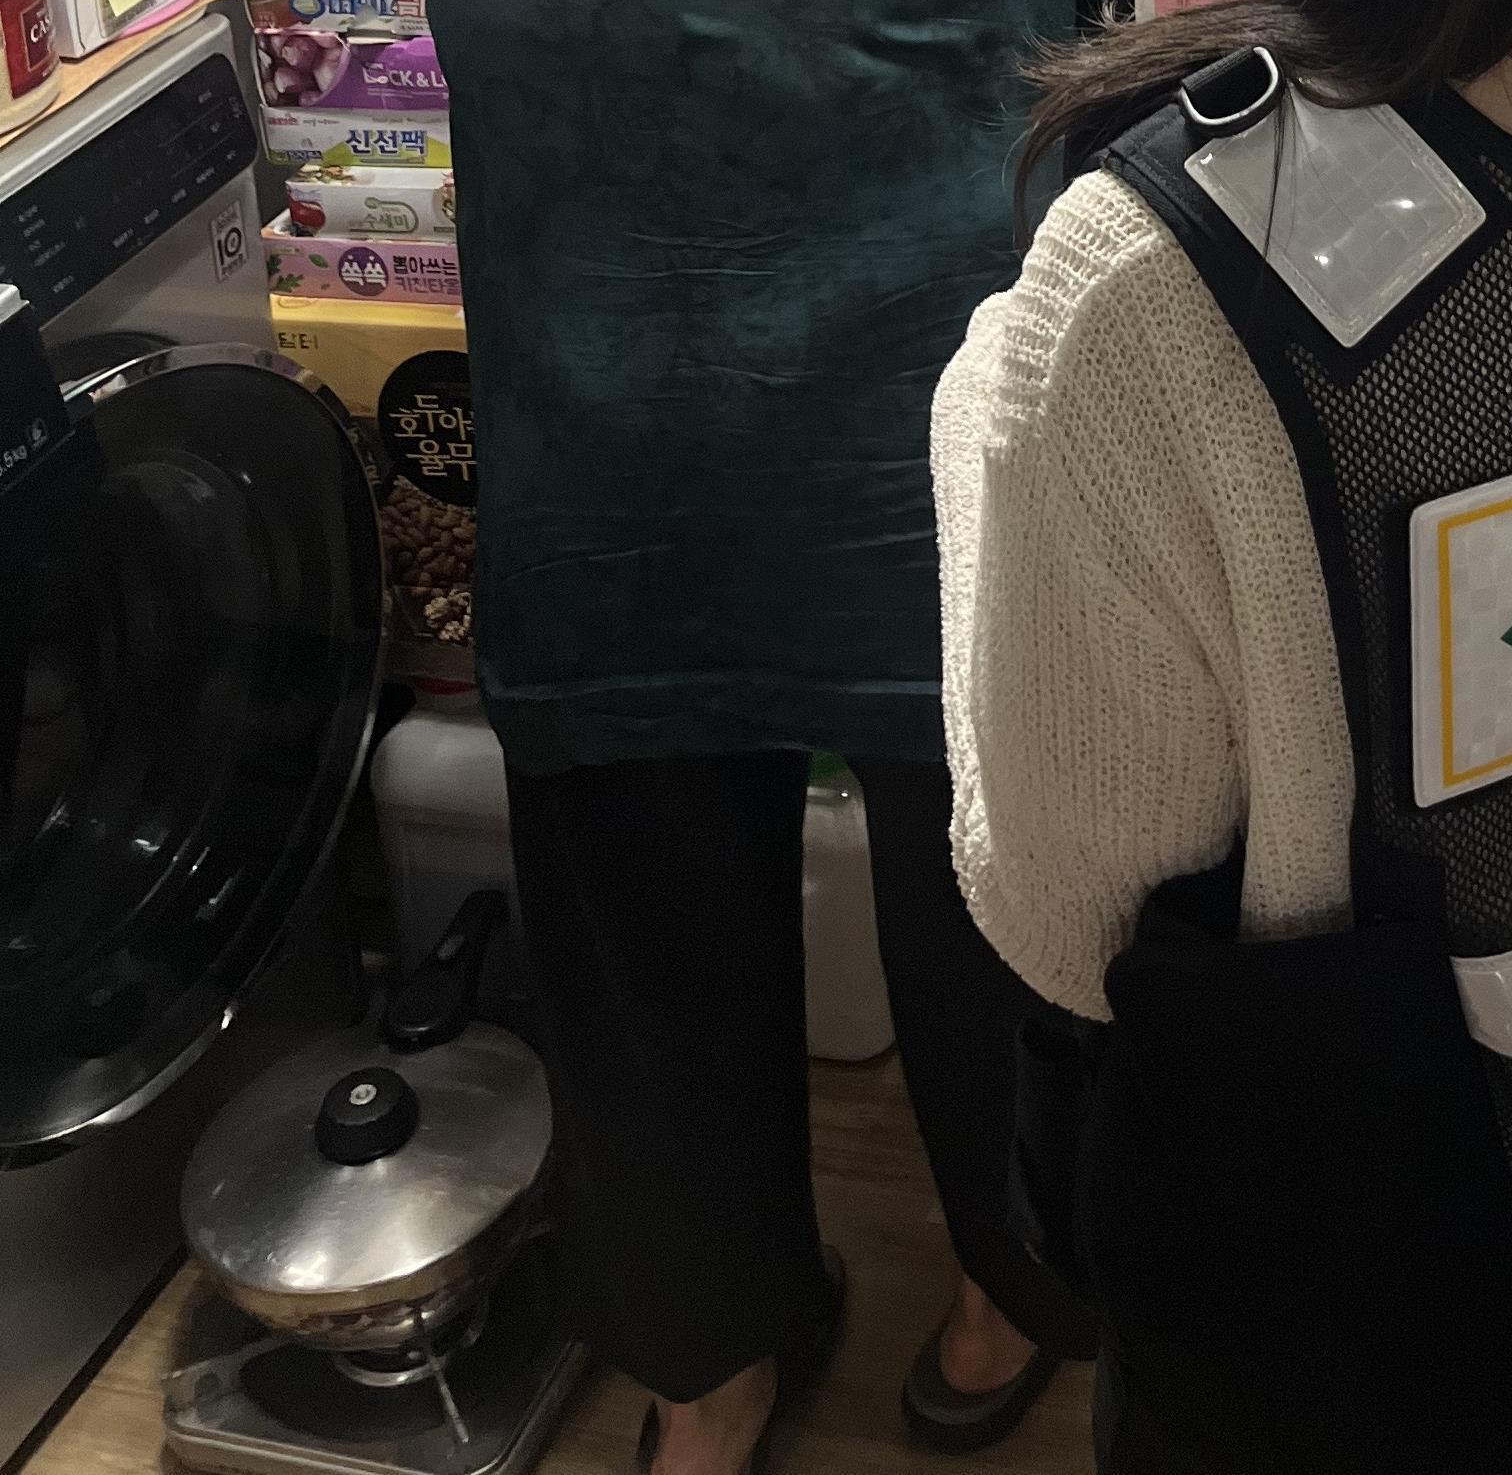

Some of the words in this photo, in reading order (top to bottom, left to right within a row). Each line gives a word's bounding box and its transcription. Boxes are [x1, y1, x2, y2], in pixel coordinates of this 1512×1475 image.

[346, 129, 427, 155] 신선팩
[393, 255, 457, 276] 뽑아쓰는
[389, 395, 475, 441] 호두아
